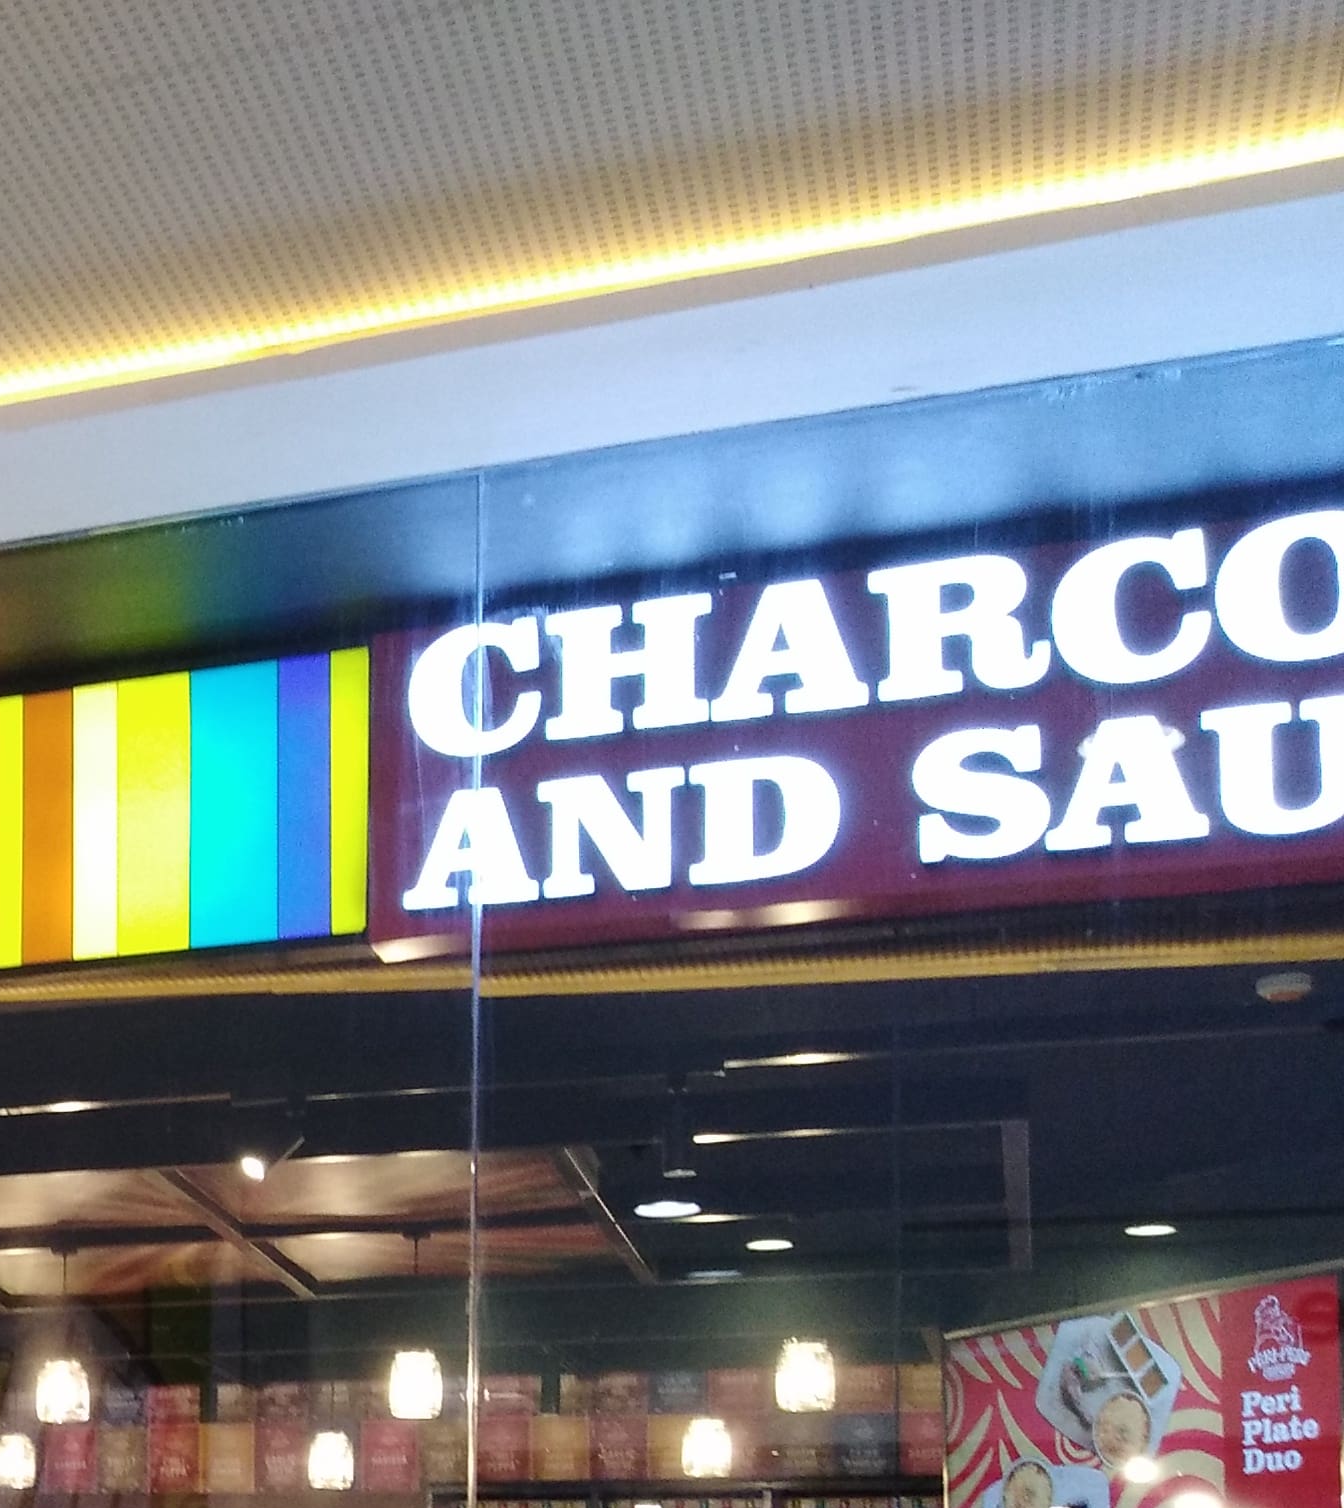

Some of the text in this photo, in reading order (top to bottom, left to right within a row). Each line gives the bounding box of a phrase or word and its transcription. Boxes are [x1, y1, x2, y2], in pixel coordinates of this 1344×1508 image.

[407, 509, 1344, 759] CHARCO
[402, 692, 1344, 912] AND SAU
[1240, 1385, 1303, 1418] Peri
[1241, 1414, 1320, 1446] Plate
[1242, 1447, 1303, 1475] Duo
